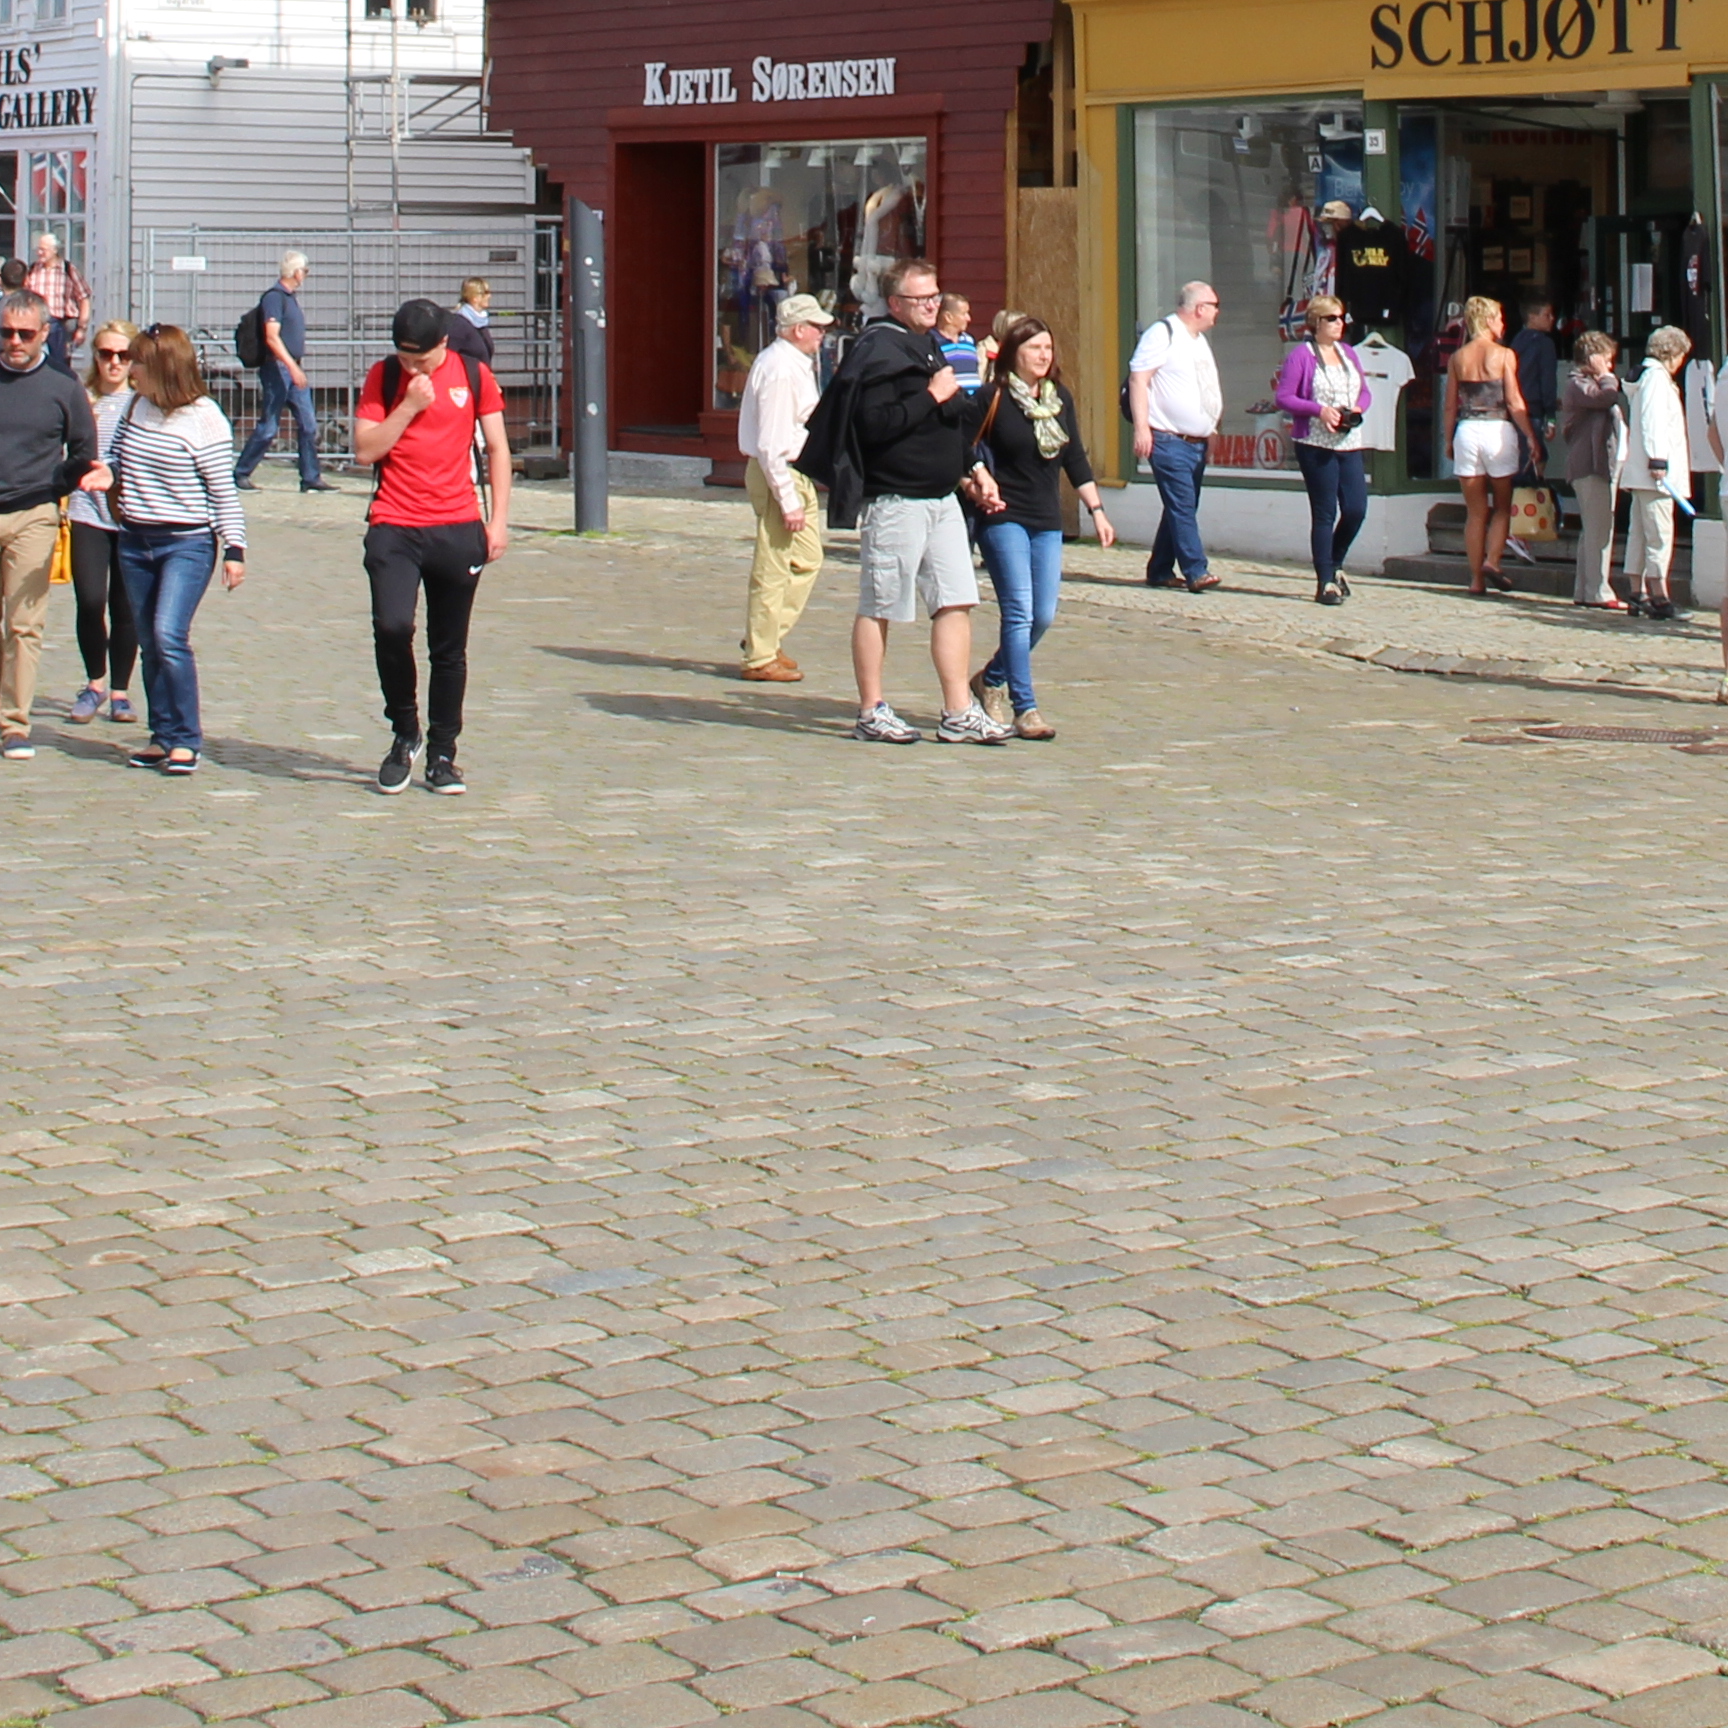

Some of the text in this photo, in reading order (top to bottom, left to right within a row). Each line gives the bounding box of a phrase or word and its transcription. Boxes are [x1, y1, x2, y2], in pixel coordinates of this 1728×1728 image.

[643, 56, 897, 106] KJETIL SØRENSEN
[1368, 136, 1379, 147] 35
